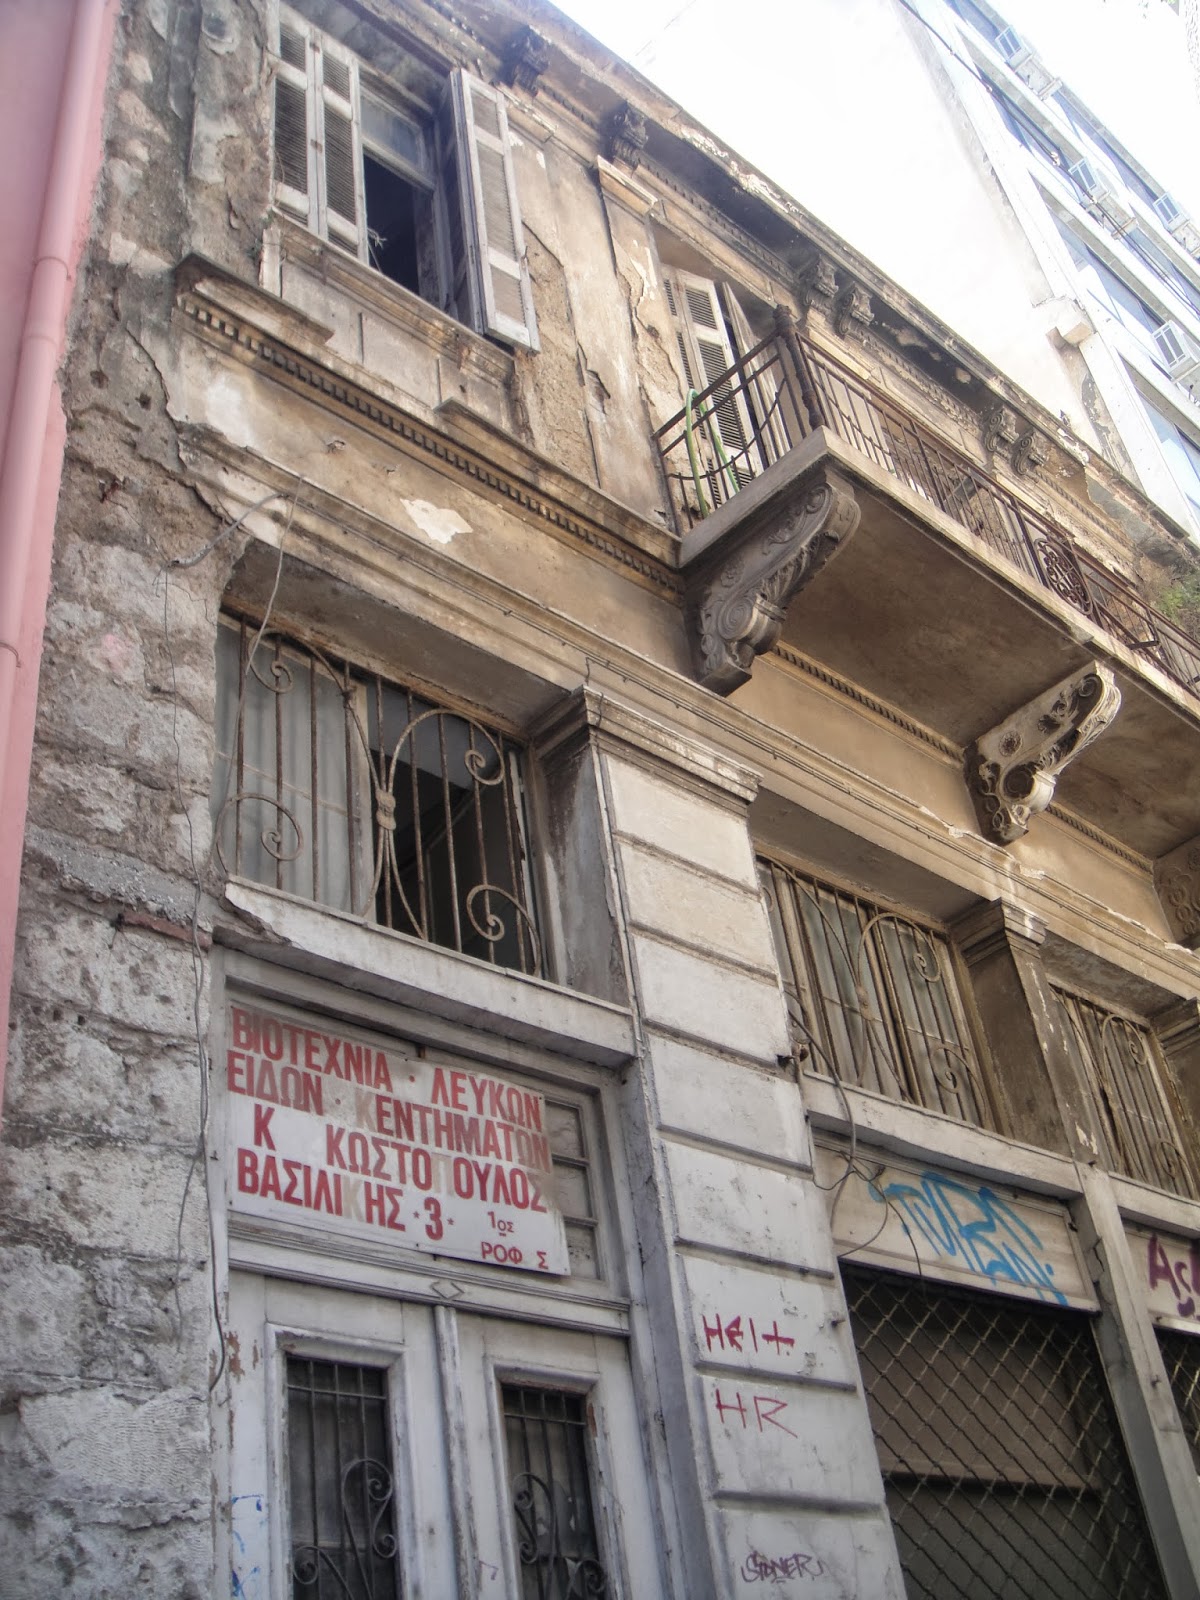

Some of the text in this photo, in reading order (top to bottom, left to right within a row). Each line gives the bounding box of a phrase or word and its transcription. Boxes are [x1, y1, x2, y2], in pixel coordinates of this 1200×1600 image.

[227, 1051, 324, 1116] ΕΙΔΩΝ
[231, 1006, 542, 1132] ΒΙΟΤΕΧΝΙΑ ΛΕΥΚΩΝ
[424, 1197, 443, 1241] 3
